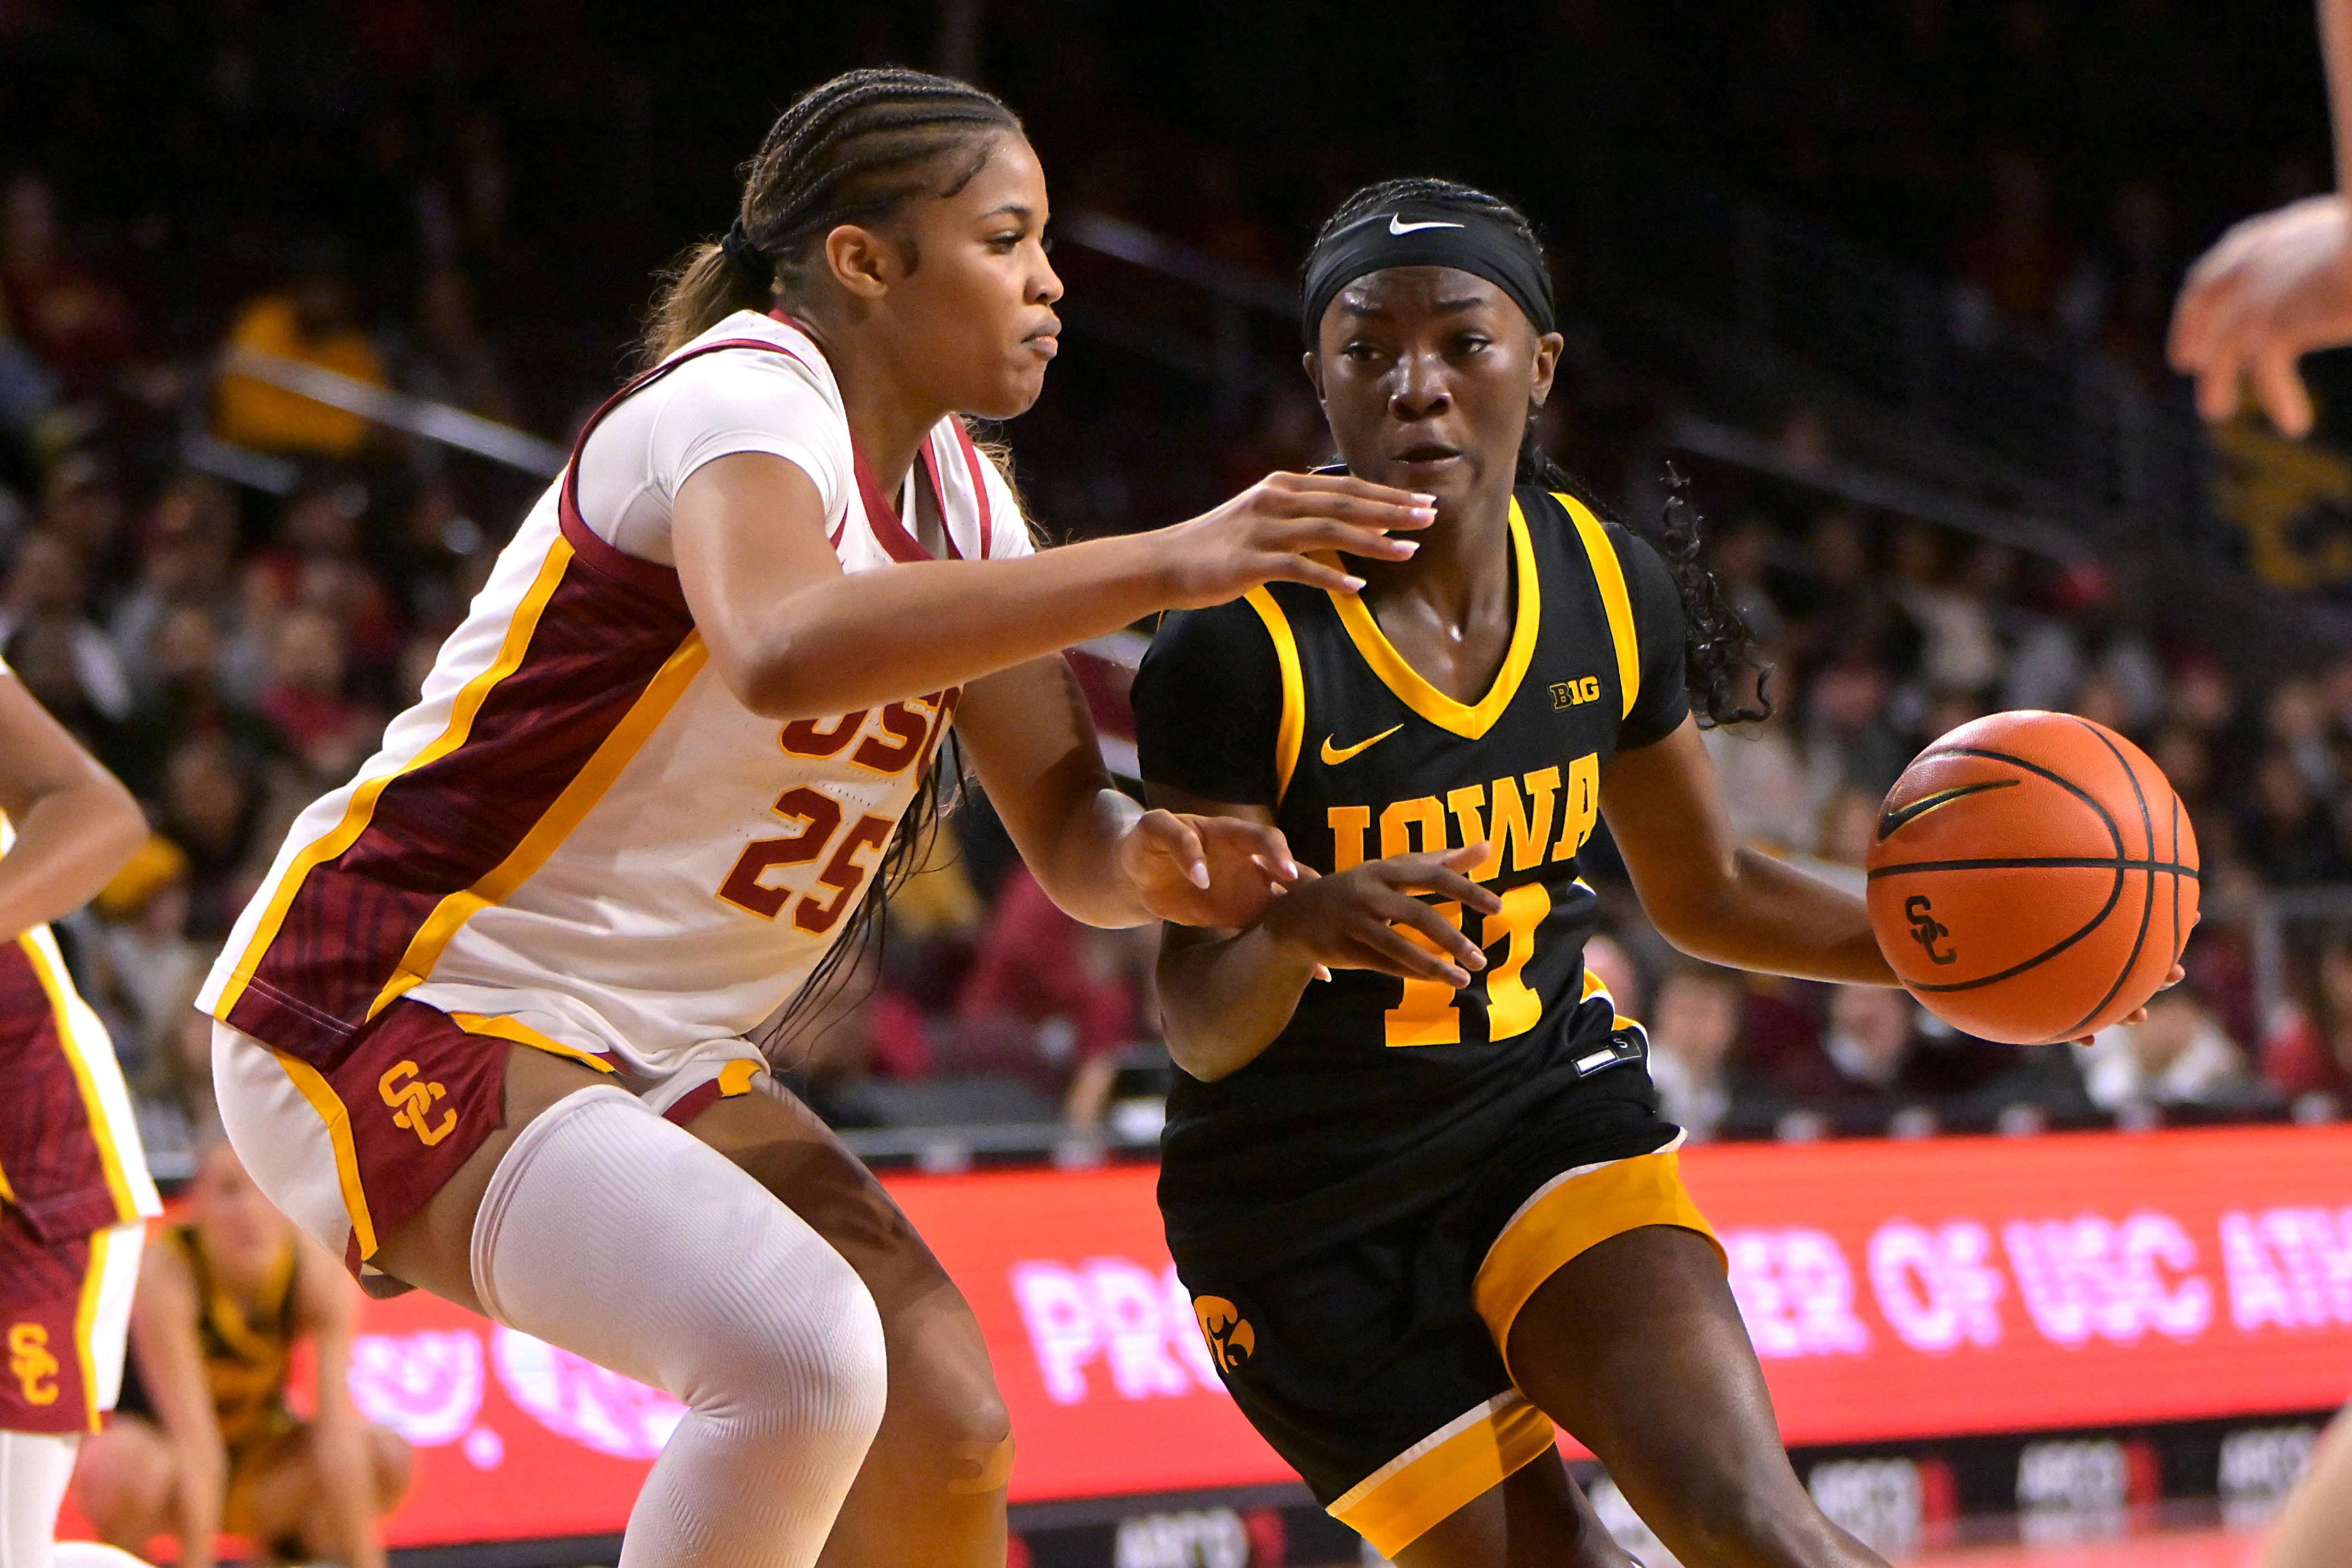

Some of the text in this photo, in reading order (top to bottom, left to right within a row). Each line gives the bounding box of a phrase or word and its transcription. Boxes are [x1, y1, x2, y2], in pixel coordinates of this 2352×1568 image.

[715, 786, 896, 936] 25
[1328, 752, 1599, 896] IOWA
[1385, 882, 1551, 1047] 11
[1905, 895, 1957, 965] SC
[379, 1060, 457, 1146] SC
[1867, 1219, 2006, 1353] OF
[2002, 1212, 2216, 1347] USC
[8, 1323, 59, 1405] SC
